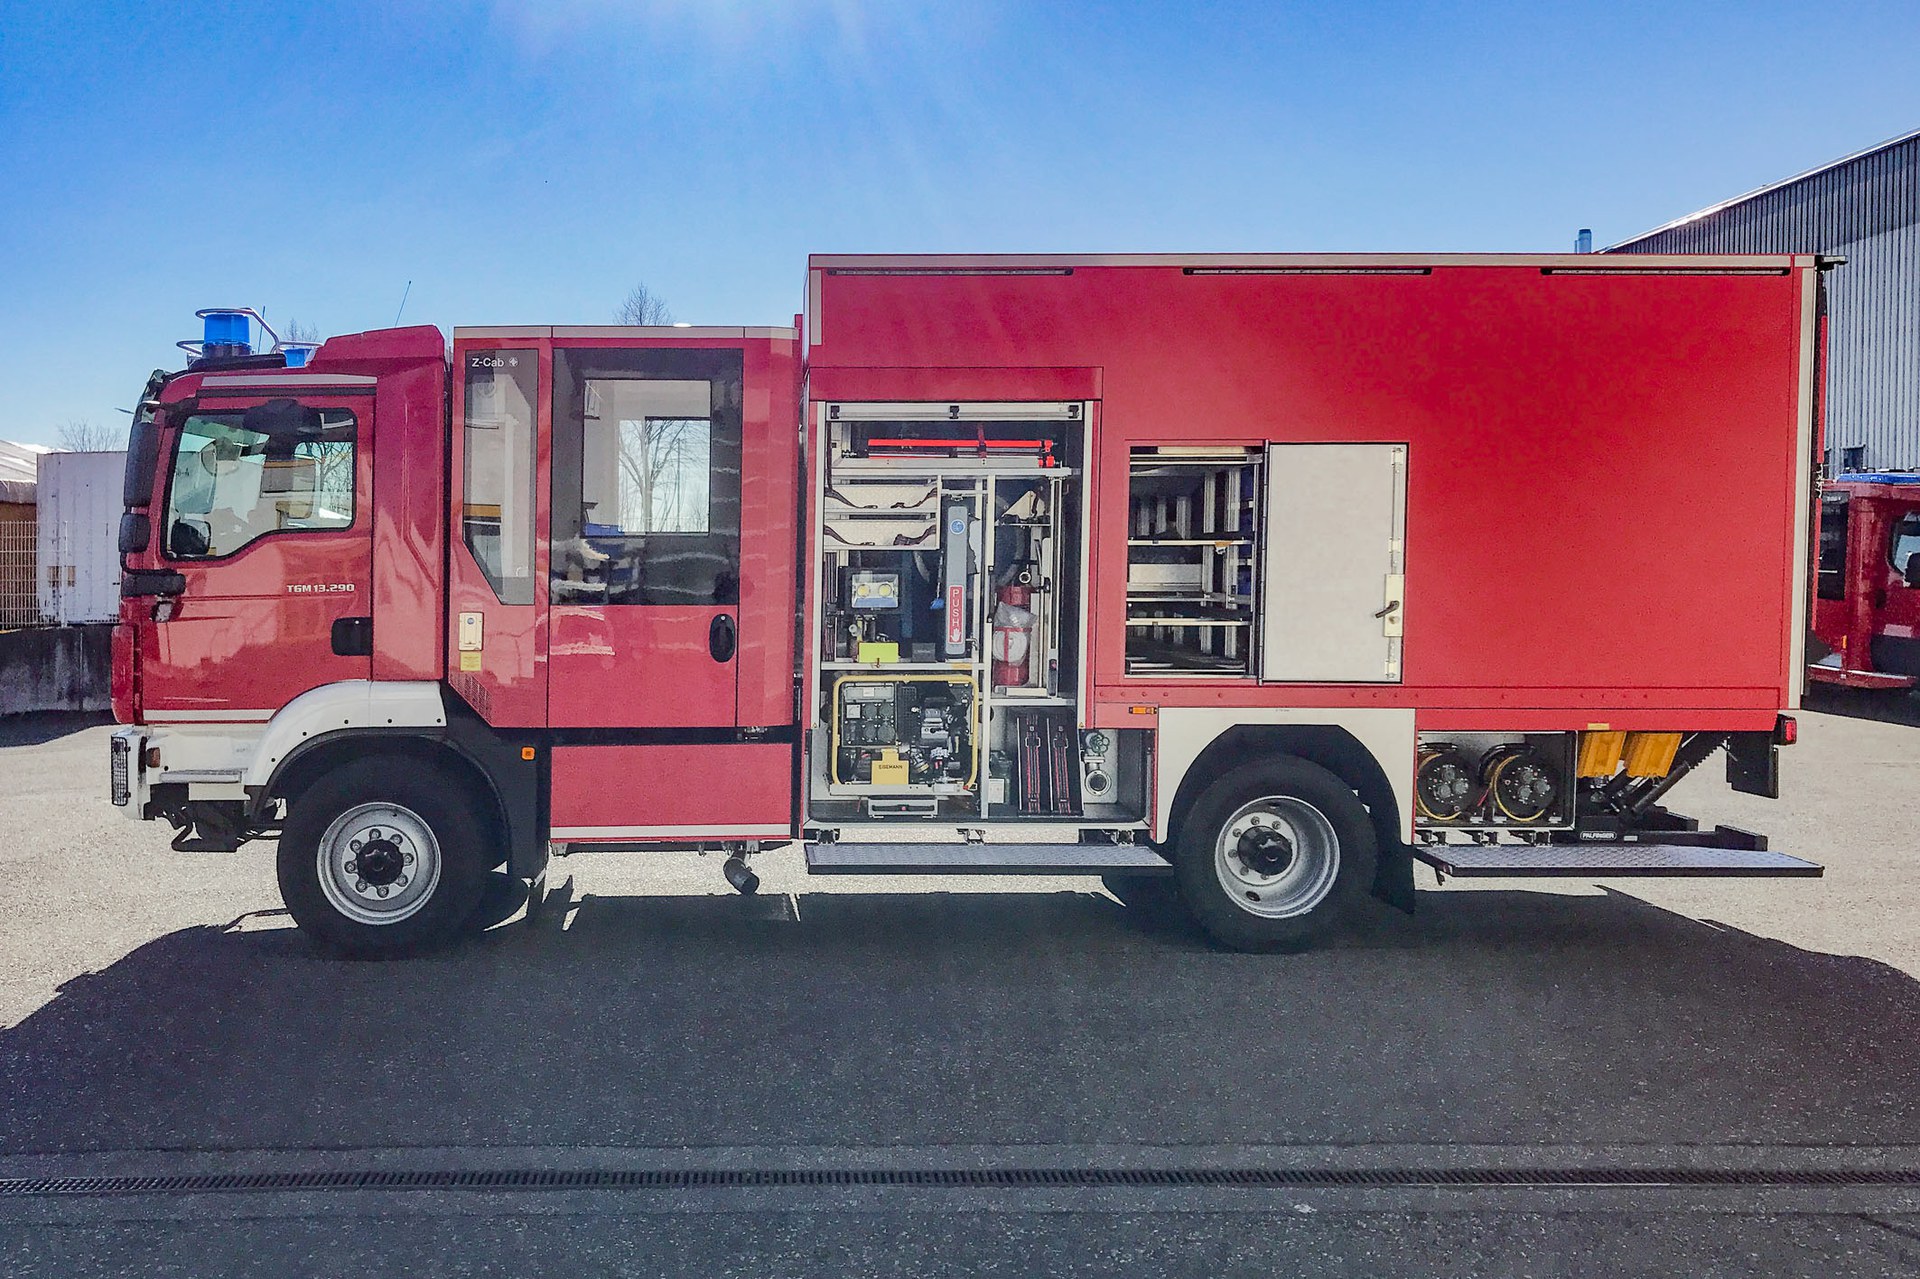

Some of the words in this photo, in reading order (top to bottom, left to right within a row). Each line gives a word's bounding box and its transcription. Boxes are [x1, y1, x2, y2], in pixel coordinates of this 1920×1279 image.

[472, 357, 504, 367] Z-Cab
[287, 584, 312, 592] TGM
[313, 584, 355, 592] 13.290
[952, 589, 960, 627] PUSH
